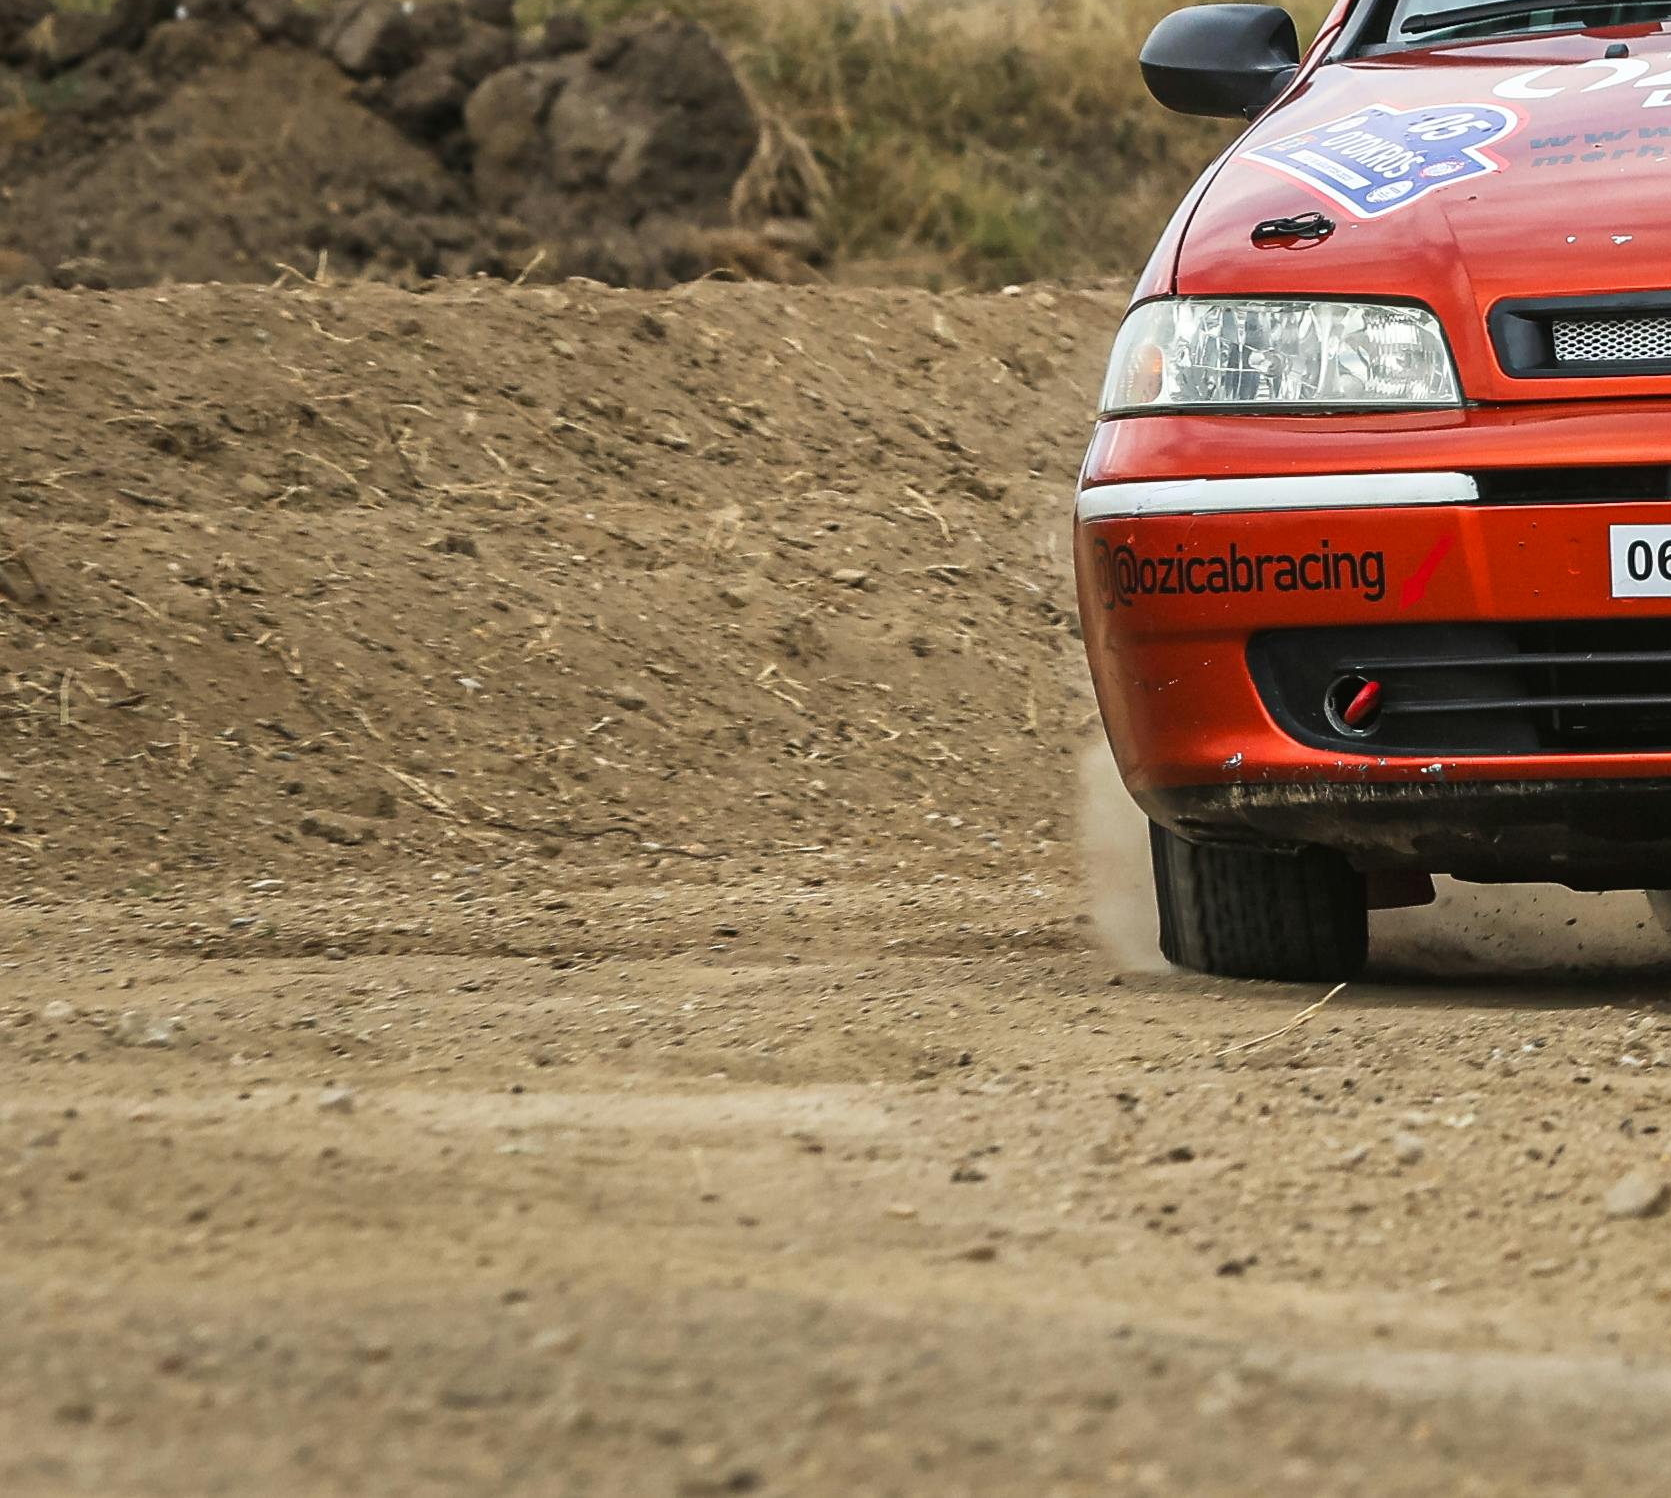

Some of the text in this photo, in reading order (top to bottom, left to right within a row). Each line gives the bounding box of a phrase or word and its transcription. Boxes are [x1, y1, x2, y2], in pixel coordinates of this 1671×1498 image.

[1410, 113, 1492, 142] 05
[1321, 130, 1425, 179] OTOKROS
[1113, 539, 1386, 607] @ozicabracing
